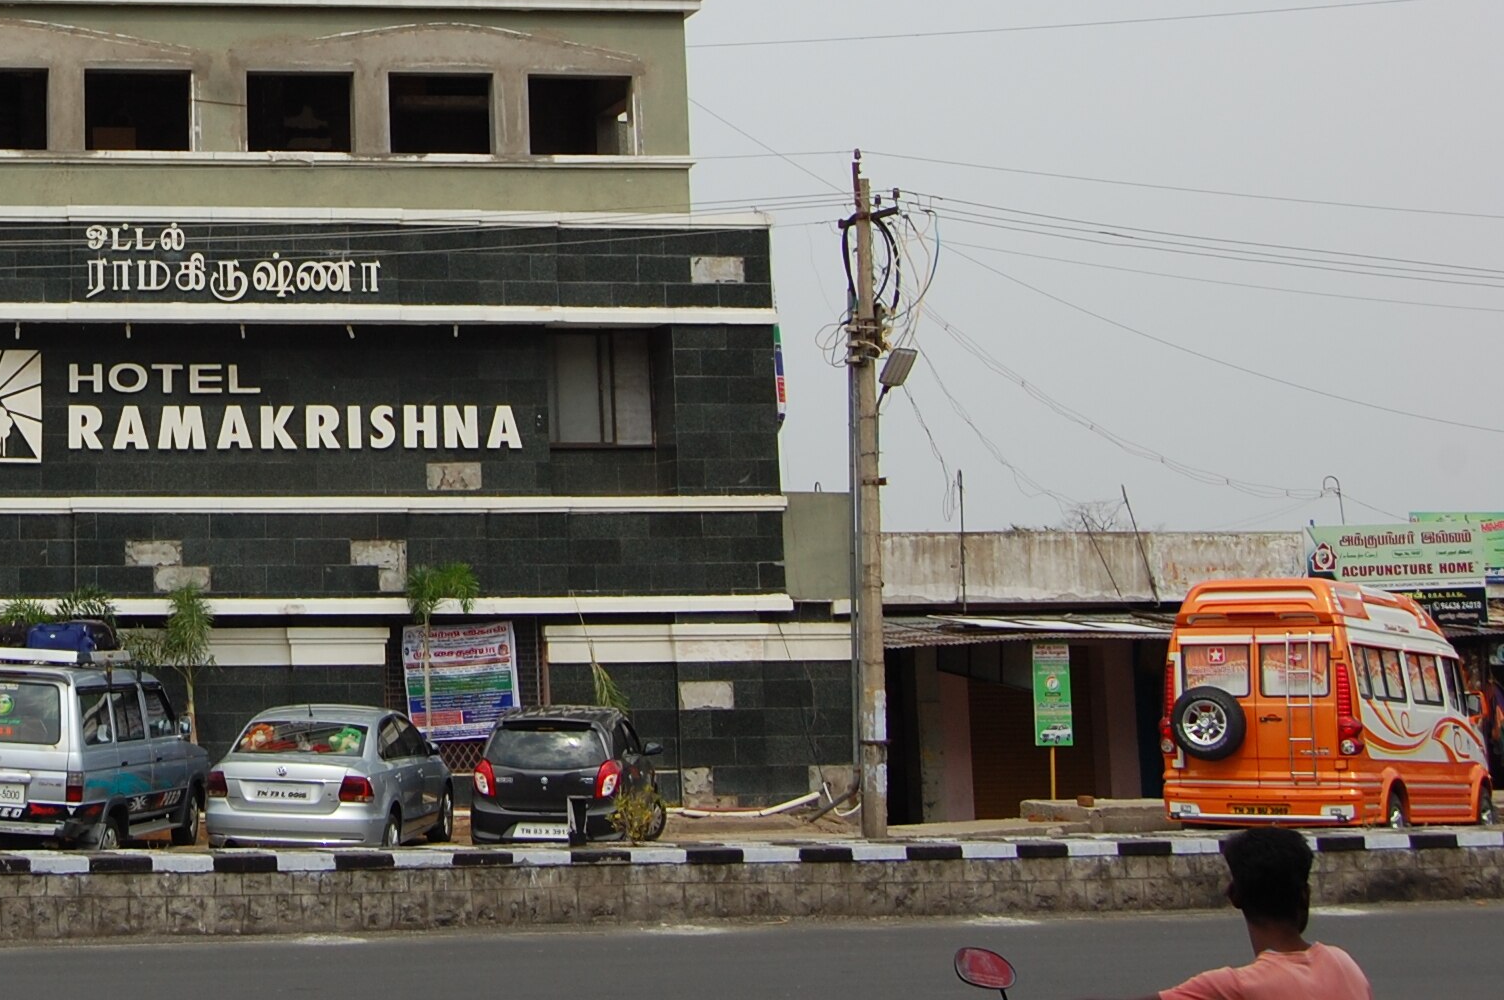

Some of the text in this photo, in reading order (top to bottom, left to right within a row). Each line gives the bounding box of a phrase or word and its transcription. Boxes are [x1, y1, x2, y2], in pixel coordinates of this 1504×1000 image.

[86, 222, 185, 250] ஓட்டல்
[86, 252, 381, 301] ராமகிருஷ்ணா
[68, 363, 261, 394] HOTEL
[68, 405, 523, 450] RAMAKRISHNA
[1421, 529, 1472, 545] இல்லம்
[1342, 561, 1475, 577] ACUPUNCTURE HOME
